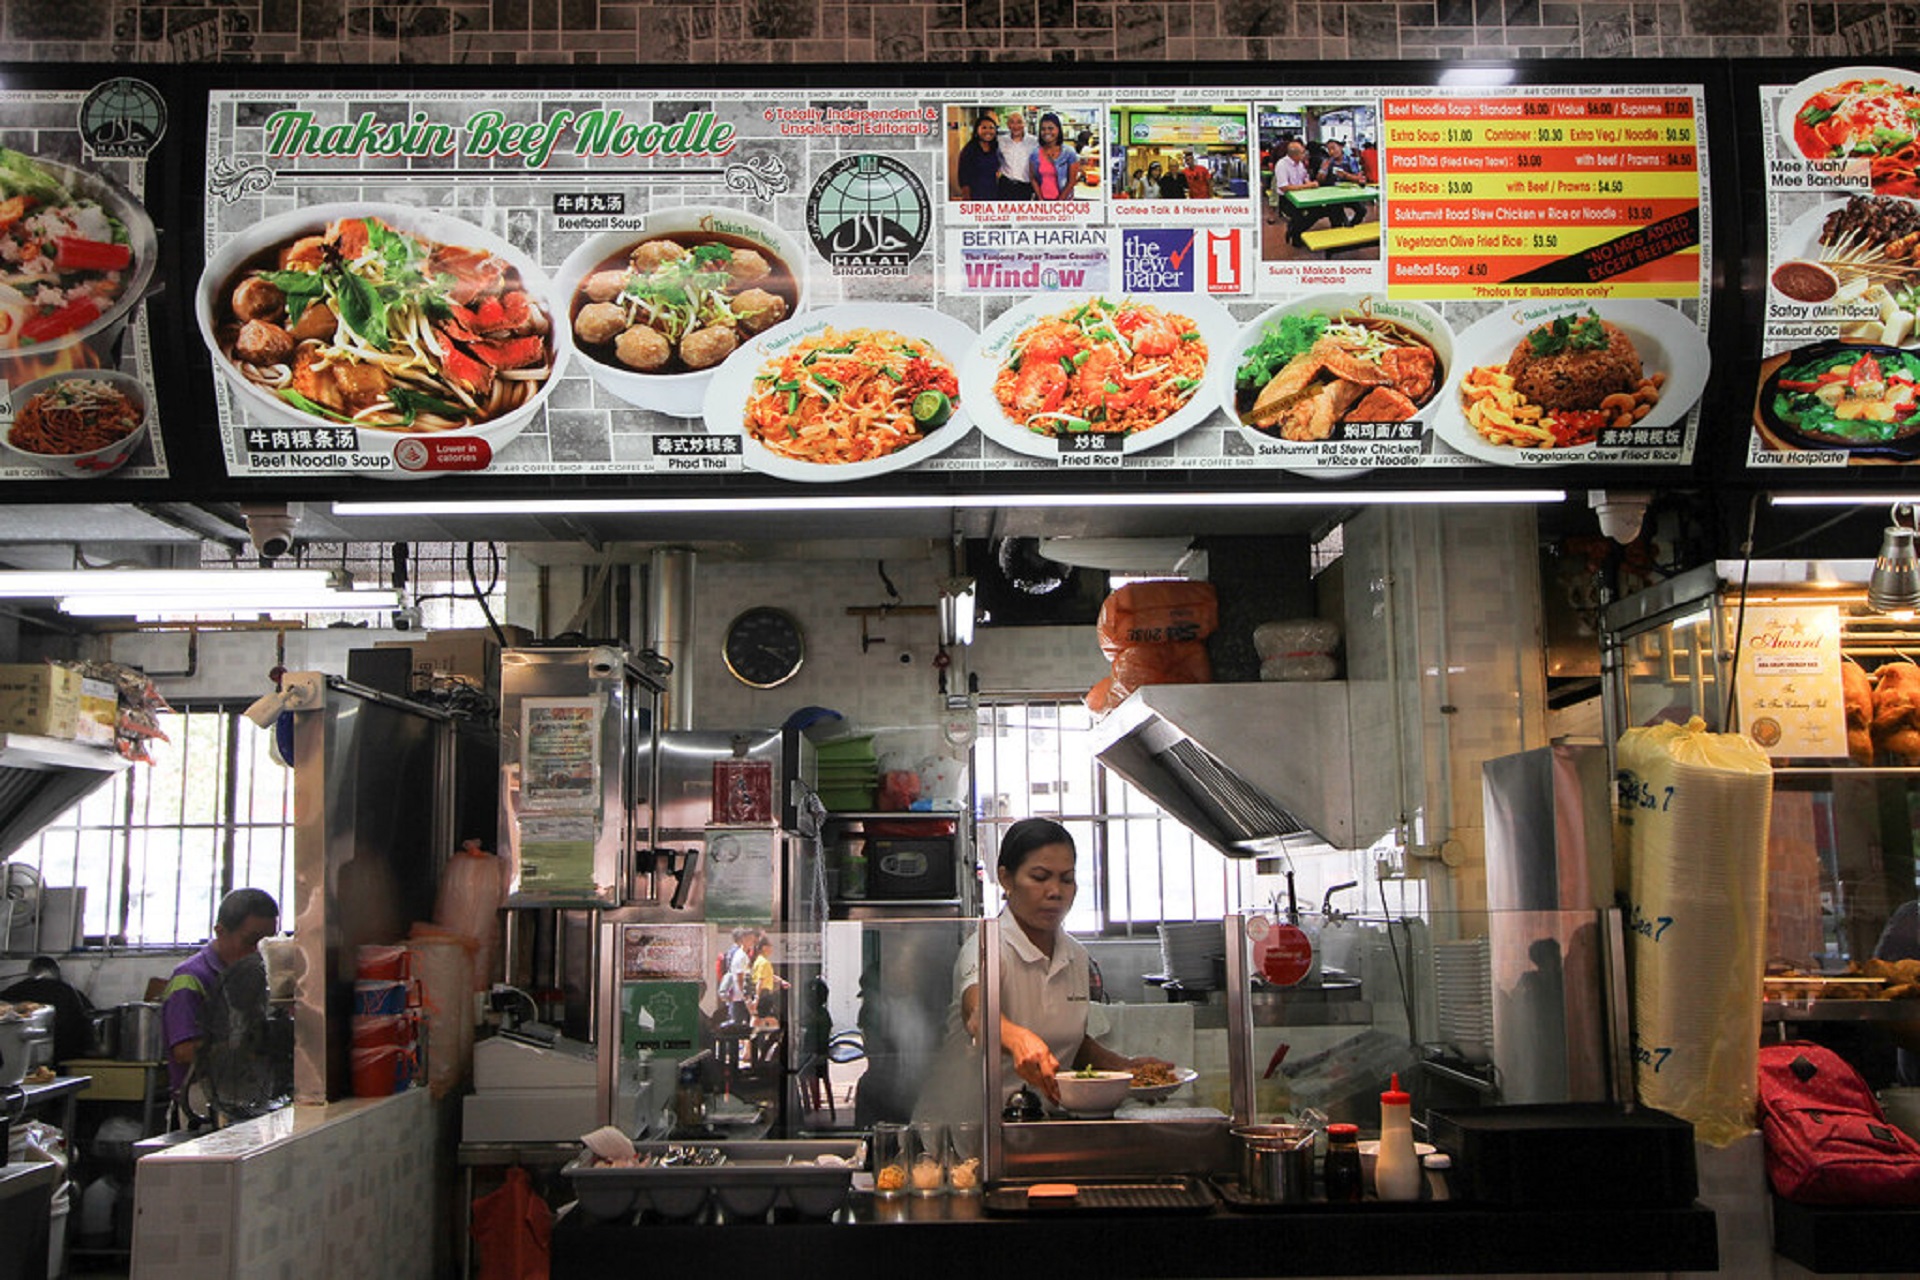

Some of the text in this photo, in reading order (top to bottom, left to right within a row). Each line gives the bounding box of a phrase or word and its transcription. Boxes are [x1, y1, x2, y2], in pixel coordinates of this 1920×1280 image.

[764, 108, 937, 121] 6 Totally Independent &
[1388, 103, 1410, 115] Beef
[1412, 103, 1446, 115] Noodle
[1448, 103, 1472, 117] Soup
[1480, 103, 1522, 115] Standard
[1558, 103, 1584, 115] Value
[1621, 103, 1662, 116] Supreme
[780, 122, 929, 134] Unsolicited Editorials
[266, 111, 735, 168] Thaksin Beef Noodle
[1391, 129, 1414, 141] Extra
[1418, 129, 1440, 143] Soup
[1448, 128, 1472, 142] $1.00
[1484, 129, 1530, 141] Container
[1538, 128, 1562, 141] $0.30
[1570, 129, 1594, 141] Extra
[1625, 129, 1658, 141] Noodle
[1666, 128, 1690, 141] $0.50
[1392, 155, 1416, 167] Phad
[1419, 155, 1438, 167] Thai
[1517, 154, 1542, 167] $3.00
[1575, 154, 1595, 165] with
[1597, 154, 1618, 165] Beef
[1627, 154, 1660, 166] Prawns
[1771, 161, 1802, 172] Mee
[1771, 173, 1869, 187] Mee Bandung
[1393, 180, 1623, 194] Fried Rice $3.00 with Beef Prawns $4.50
[959, 202, 1090, 214] SURIA MAKANLICIOUS
[1116, 206, 1249, 214] Coffee Talk & Hawker Woks
[1394, 208, 1443, 221] Sukhumvit
[1445, 208, 1470, 219] Road
[1496, 208, 1535, 219] Chicken
[1548, 208, 1568, 219] Rice
[1570, 211, 1580, 219] or
[1582, 208, 1616, 219] Noodle
[558, 217, 642, 231] Beefball Soup
[962, 230, 1106, 246] BERITA HARIAN
[1614, 233, 1644, 254] MSG
[1647, 217, 1689, 243] ADDED
[1125, 236, 1160, 258] the
[1395, 235, 1557, 251] Vegetarian Olive Fried Rice $3.50
[835, 256, 905, 265] HALAL
[1125, 256, 1169, 273] new
[832, 266, 909, 276] SINGAPORE
[965, 262, 1086, 288] Window
[1269, 265, 1372, 275] Suria's Makan Boomz
[1395, 263, 1488, 277] Beefball Soup 4.50
[1588, 259, 1635, 281] EXCEPT
[1125, 270, 1184, 292] paper
[1301, 276, 1346, 284] Kembara
[1514, 287, 1527, 296] for
[1530, 287, 1585, 296] illustration
[1770, 304, 1809, 318] Satay
[1767, 326, 1812, 337] Ketupat
[436, 445, 466, 453] Lower
[1258, 443, 1420, 455] Sukhumvit Rd Stew Chicken
[251, 454, 390, 469] Beef Noodle Soup
[437, 454, 477, 463] calories
[669, 457, 727, 469] Phad Thai
[1062, 454, 1119, 465] Fried Rice
[1360, 457, 1373, 465] or
[1375, 455, 1419, 465] Noodle
[1520, 451, 1678, 463] Vegetarian Olive Fried Rice
[1751, 452, 1844, 465] Tahu Hotplate
[1750, 631, 1824, 649] Award
[1663, 786, 1674, 811] 7
[1655, 916, 1673, 942] 7
[1654, 1047, 1672, 1072] 7
